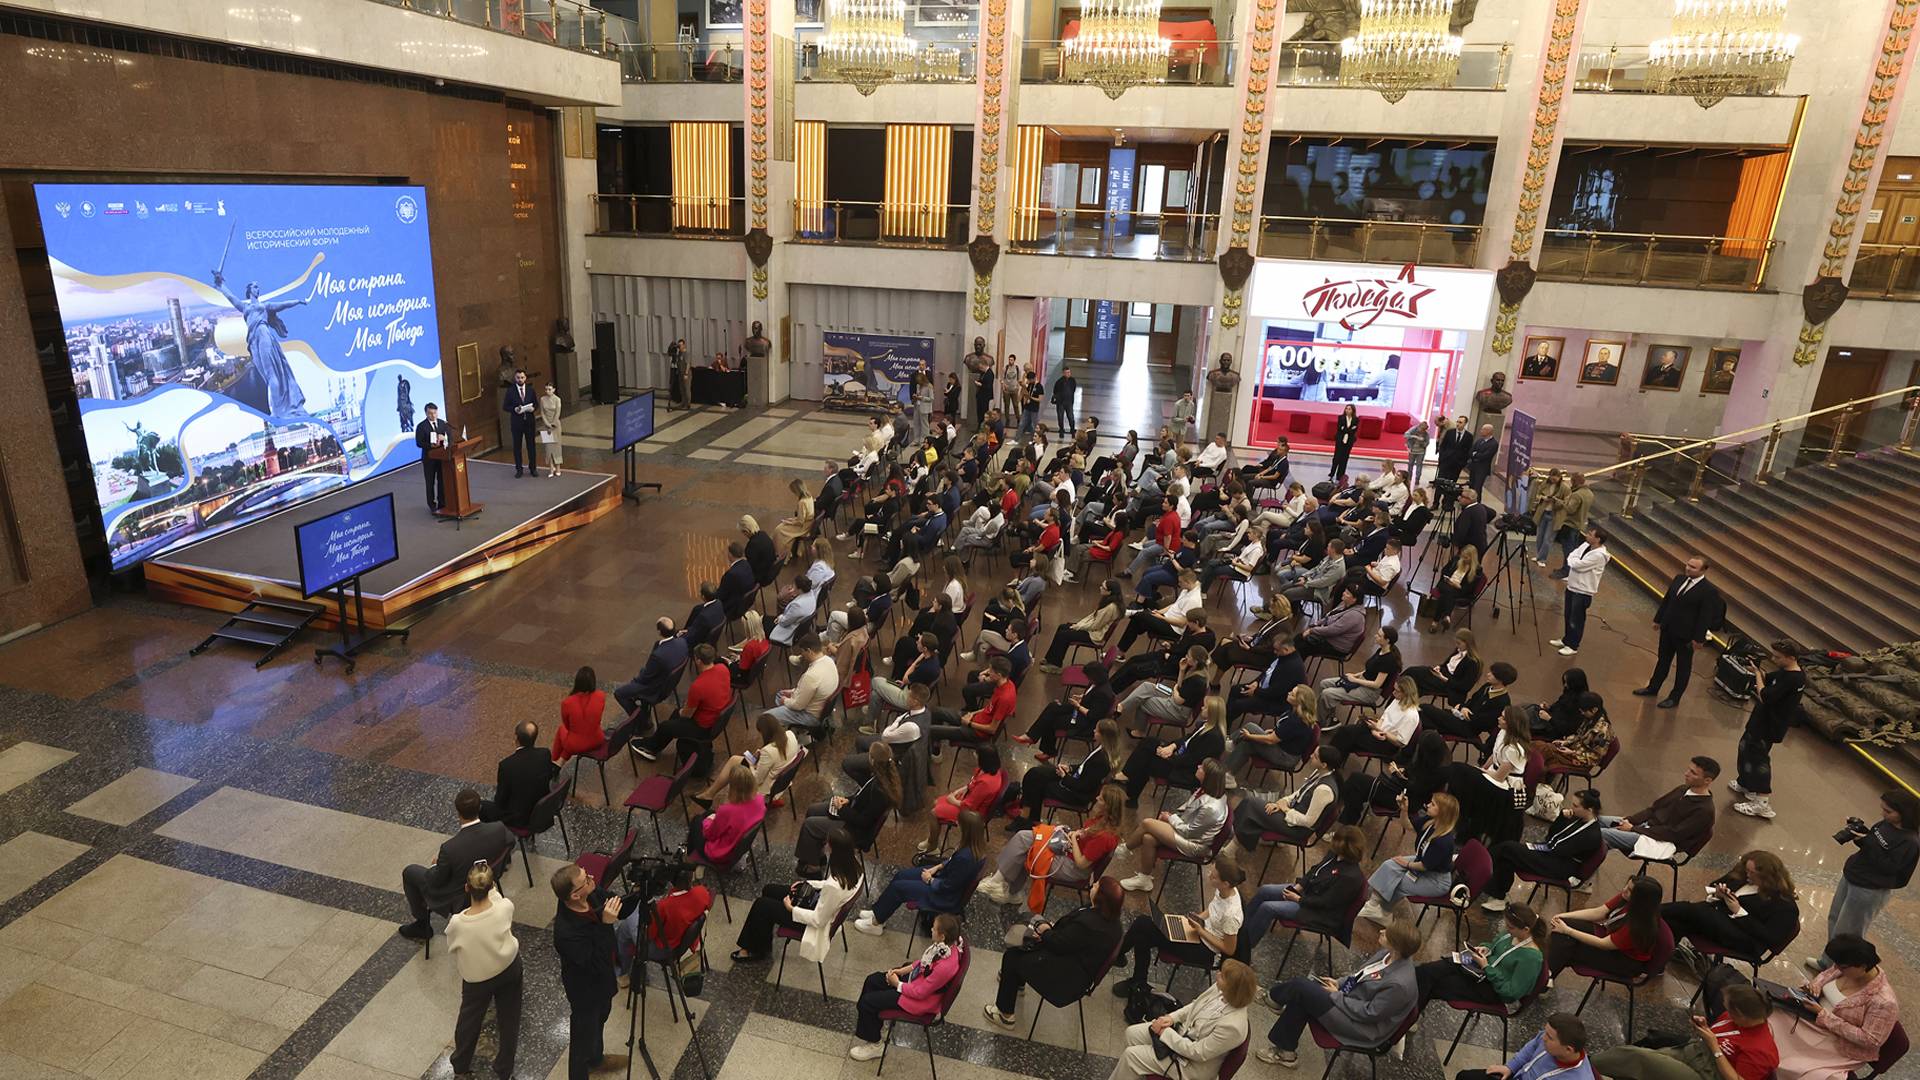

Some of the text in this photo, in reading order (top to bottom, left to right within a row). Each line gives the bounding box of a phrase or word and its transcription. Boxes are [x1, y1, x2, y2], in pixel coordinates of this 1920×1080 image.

[245, 225, 370, 240] ВСЕРОССИЙСКИЙ МОЛОДЕЖНЫЙ
[247, 236, 339, 250] ИСТОРИЧЕСКИЙ ФОРУМ
[305, 271, 405, 302] Моя страна.
[325, 296, 431, 330] Моя история.
[345, 319, 425, 357] Моя Победа
